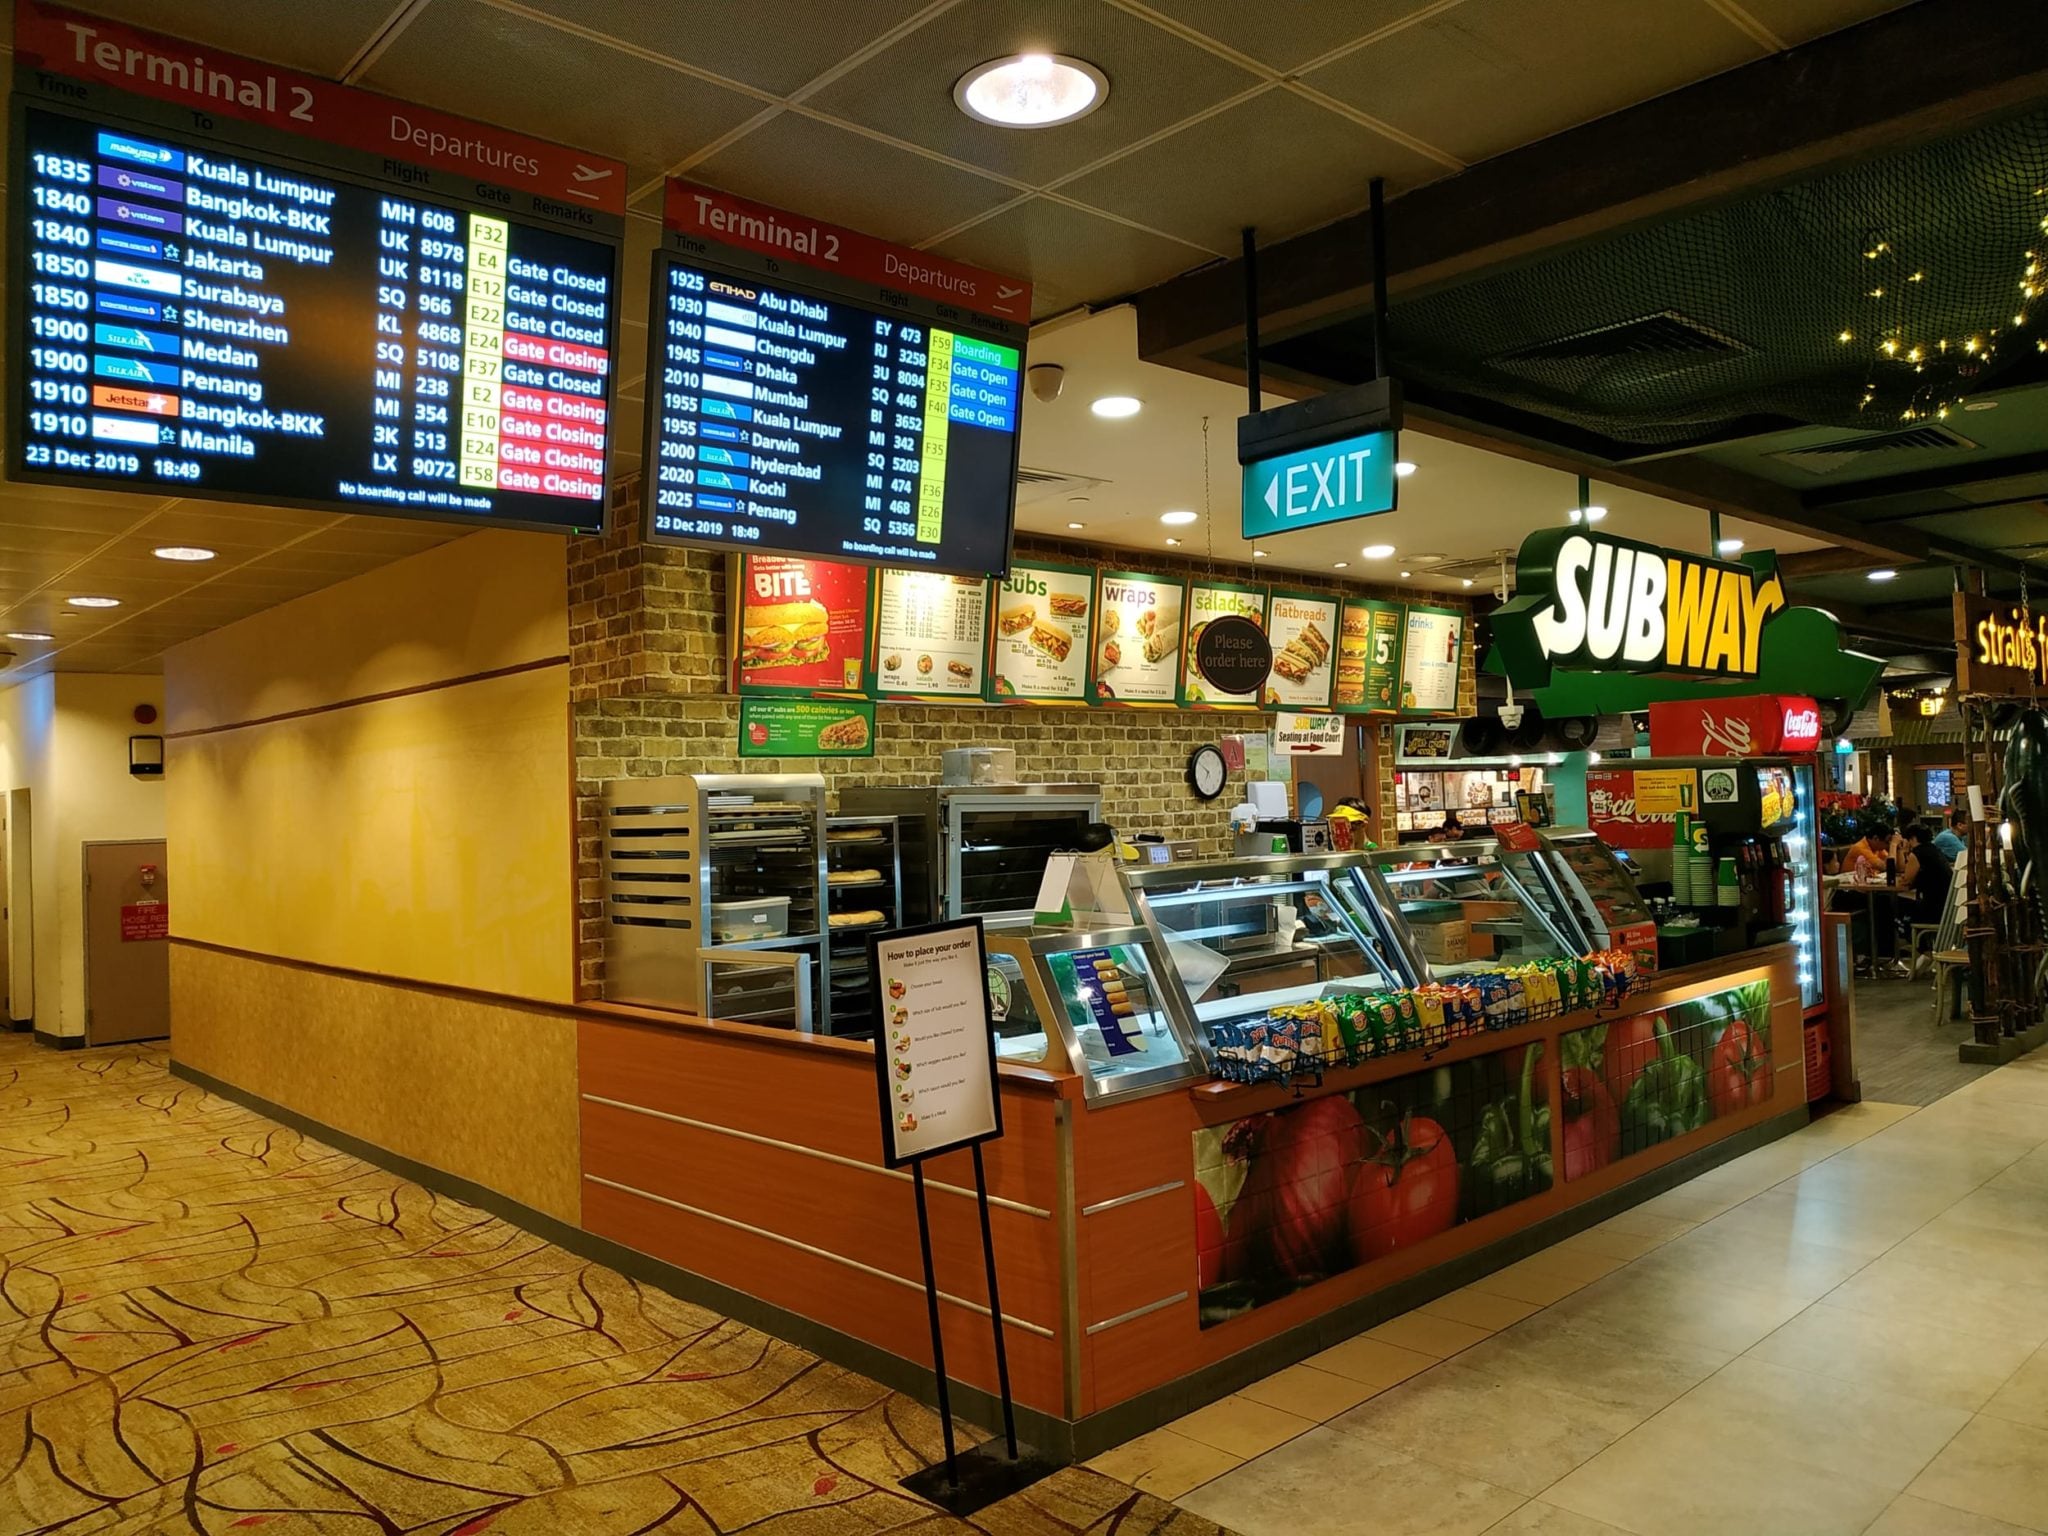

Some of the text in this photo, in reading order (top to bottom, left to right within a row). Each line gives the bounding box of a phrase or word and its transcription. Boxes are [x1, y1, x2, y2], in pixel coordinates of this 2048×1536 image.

[66, 23, 314, 122] Terminal 2
[38, 74, 88, 100] Time
[192, 111, 213, 130] To
[391, 115, 539, 176] Departures
[33, 155, 91, 183] 1835
[187, 156, 335, 206] Kuala Lumpur
[383, 160, 430, 185] Flight
[33, 188, 90, 215] 1840
[475, 184, 511, 205] Gate
[187, 187, 330, 235] Bangkok-BKK
[381, 200, 455, 233] MH 608
[532, 198, 593, 224] Remarks
[32, 220, 90, 246] 1840
[186, 218, 333, 264] Kuala Lumpur
[474, 224, 503, 243] F32
[694, 195, 840, 262] Terminal 2
[381, 229, 464, 263] UK 8978
[32, 253, 89, 278] 1850
[184, 248, 263, 280] Jakarta
[479, 251, 497, 270] E4
[380, 257, 463, 290] UK 8118
[509, 259, 606, 294] Gate Closed
[671, 270, 704, 291] 1925
[885, 253, 976, 296] Departures
[32, 285, 88, 310] 1850
[184, 279, 284, 315] Surabaya
[472, 278, 501, 297] E12
[709, 281, 756, 300] ETIHAD
[379, 286, 451, 316] SQ 966
[507, 285, 604, 320] Gate Closed
[670, 295, 702, 316] 1930
[759, 292, 828, 322] Abu Dhabi
[184, 310, 288, 343] Shenzhen
[471, 305, 500, 324] E22
[31, 317, 88, 342] 1900
[377, 314, 461, 345] KL 4868
[506, 312, 603, 345] Gate Closed
[668, 319, 701, 340] 1940
[758, 316, 846, 349] Kuala Lumpur
[183, 340, 258, 367] Medan
[470, 333, 499, 351] E24
[667, 344, 700, 364] 1945
[757, 339, 815, 365] Chengdu
[954, 341, 1001, 366] Boarding
[31, 349, 87, 373] 1900
[377, 343, 459, 372] SQ 5108
[469, 359, 497, 378] F37
[505, 338, 608, 375] Gate Closing
[182, 369, 262, 402] Penang
[376, 370, 448, 397] MI 238
[504, 365, 601, 395] Gate Closed
[664, 369, 699, 388] 2010
[756, 363, 797, 384] Dhaka
[953, 361, 1008, 386] Gate Open
[31, 381, 87, 404] 1910
[473, 387, 492, 403] E2
[664, 393, 698, 412] 1955
[754, 385, 808, 409] Mumbai
[951, 383, 1006, 406] Gate Open
[182, 400, 325, 436] Bangkok-BKK
[375, 398, 448, 425] MI 354
[503, 391, 606, 424] Gate Closing
[30, 412, 86, 436] 1910
[467, 415, 496, 430] E10
[502, 417, 605, 449] Gate Closing
[663, 418, 697, 436] 1955
[753, 409, 842, 438] Kuala Lumpur
[181, 429, 255, 455] Manila
[374, 426, 446, 450] 3K 513
[466, 440, 495, 456] E24
[661, 441, 695, 460] 2000
[752, 433, 800, 454] Darwin
[26, 446, 200, 479] 23 Dec 2019 18:49
[373, 454, 456, 480] LX 9072
[501, 442, 604, 474] Gate Closing
[751, 456, 821, 480] Hyderabad
[465, 465, 493, 482] F58
[500, 469, 603, 500] Gate Closing
[659, 466, 694, 484] 2020
[1286, 449, 1371, 517] EXIT
[339, 482, 491, 510] No boarding call will be made
[658, 490, 693, 508] 2025
[749, 479, 786, 497] Kochi
[748, 502, 797, 524] Penang
[754, 570, 811, 598] BITE
[1003, 573, 1047, 597] subs
[1105, 586, 1156, 608] wraps
[1195, 591, 1245, 613] salads
[1532, 535, 1785, 675] SUBWAY
[1274, 603, 1327, 622] flatbreads
[1409, 616, 1434, 630] drinks
[1214, 634, 1254, 650] Please
[1375, 633, 1389, 665] 5
[1204, 653, 1266, 668] order here
[796, 704, 838, 715] 500 calories
[1294, 715, 1329, 730] SUBWAY
[1783, 708, 1818, 738] Coca-Cola
[1278, 731, 1341, 743] Seating at Food Court
[123, 914, 168, 924] HOSE REE
[138, 906, 158, 914] FIRE
[887, 952, 904, 961] How
[915, 946, 934, 958] place
[935, 945, 951, 954] your
[952, 939, 971, 949] order
